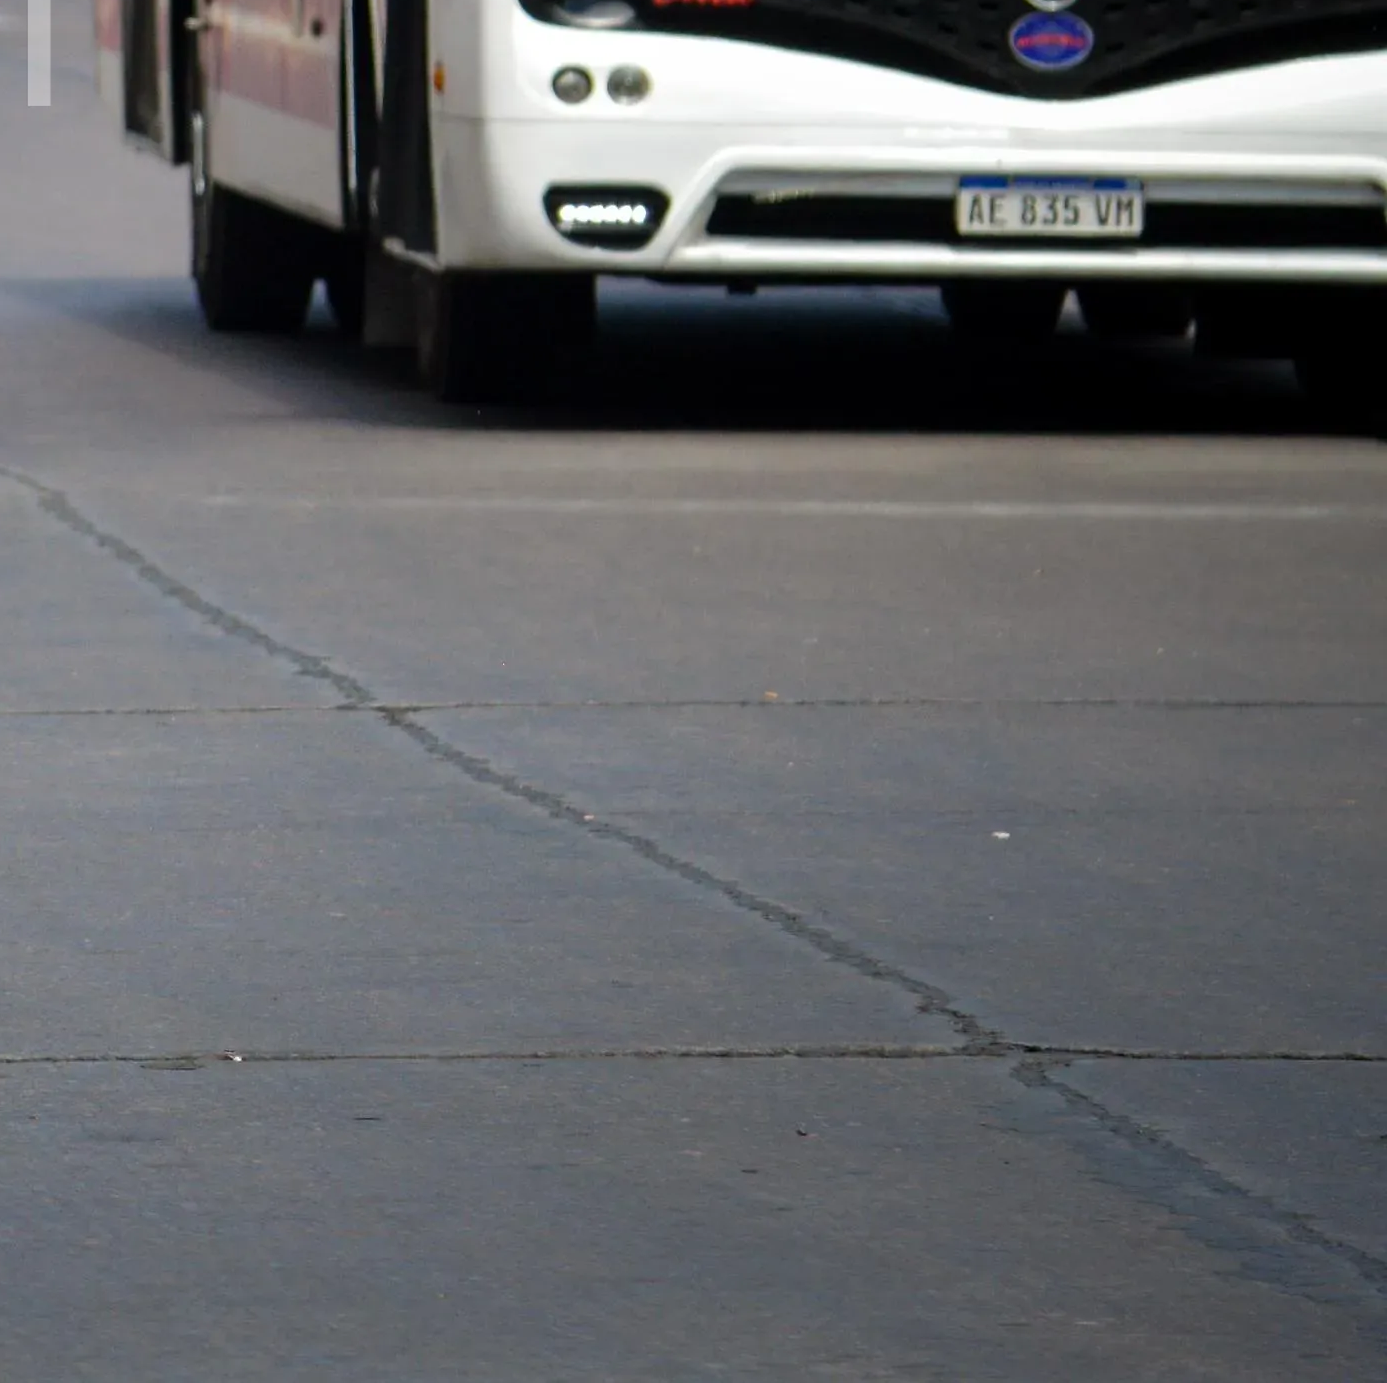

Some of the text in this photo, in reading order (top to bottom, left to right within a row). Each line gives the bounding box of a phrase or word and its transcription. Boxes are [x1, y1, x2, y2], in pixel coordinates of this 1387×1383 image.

[969, 194, 1135, 227] AE 835 VM
